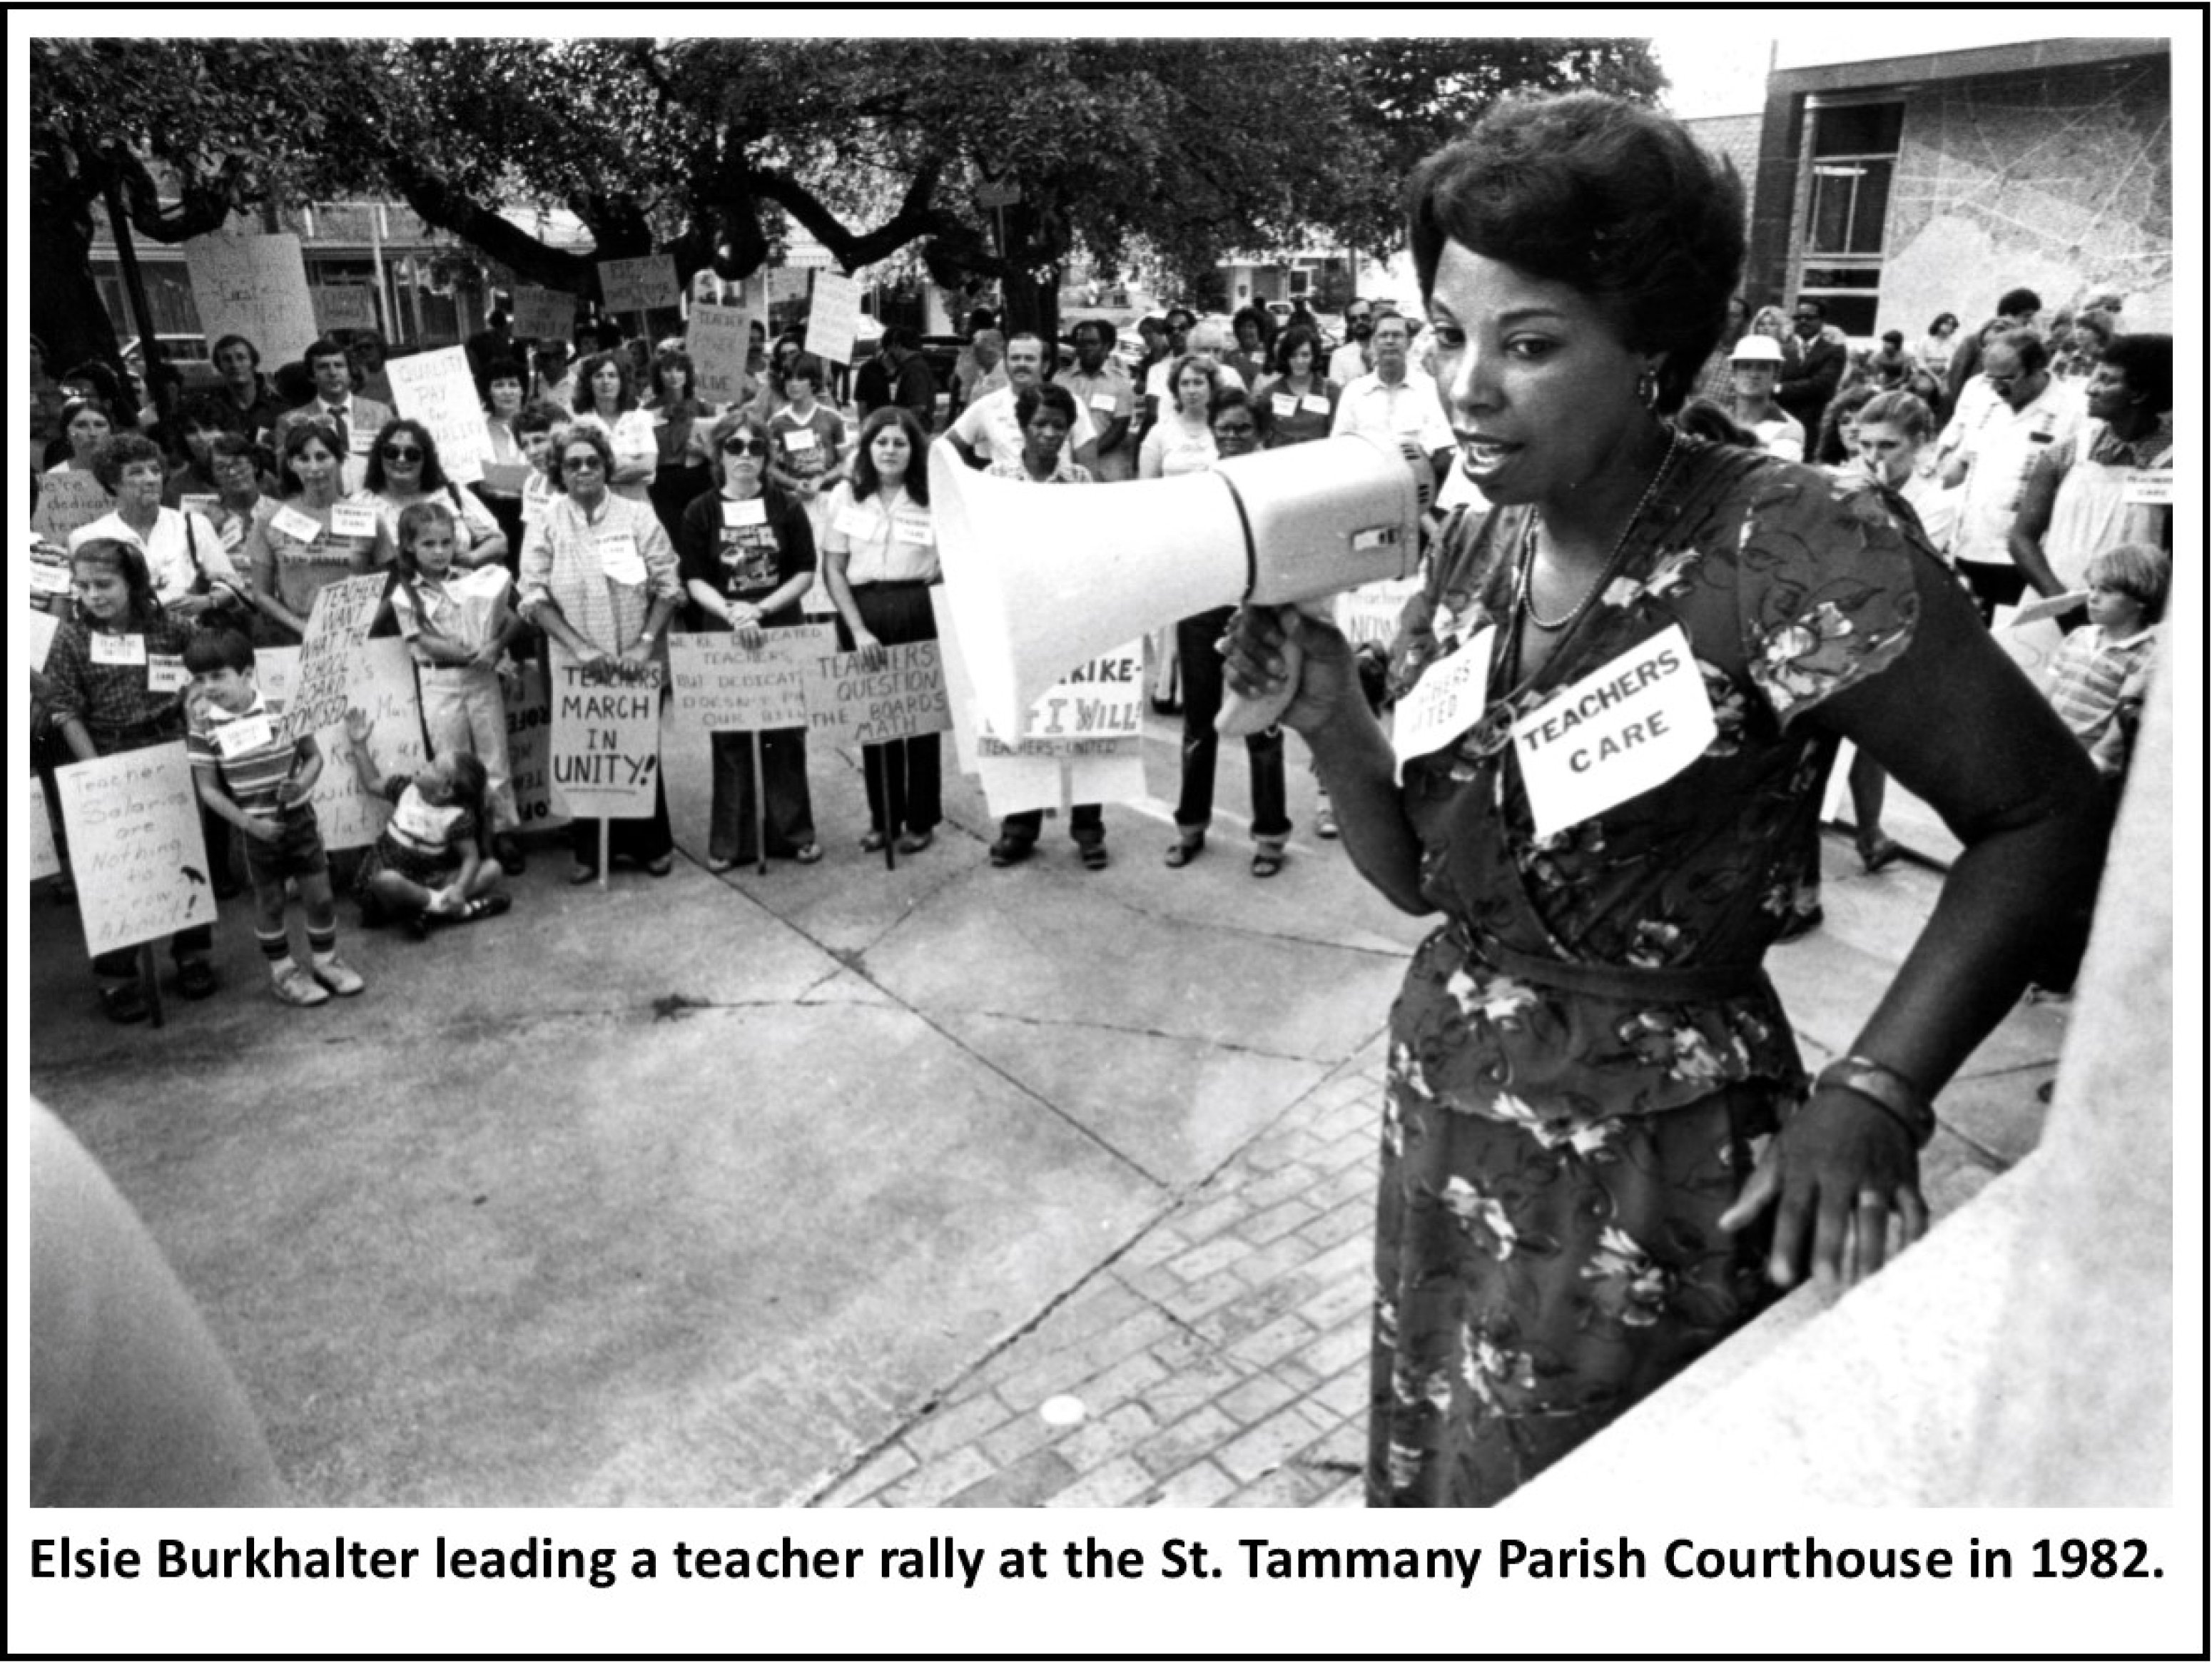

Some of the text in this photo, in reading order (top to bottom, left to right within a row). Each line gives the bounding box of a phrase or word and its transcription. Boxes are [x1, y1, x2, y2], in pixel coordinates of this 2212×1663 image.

[731, 628, 822, 647] DICATED
[718, 672, 805, 689] DEDICAT
[836, 669, 939, 702] QUESTION
[1057, 657, 1142, 685] RIKE-
[562, 695, 649, 720] MARCH
[811, 692, 947, 727] THE BOARDS
[1521, 649, 1681, 752] TEACHERS
[587, 728, 617, 750] IN
[856, 714, 917, 740] MATH
[1569, 709, 1670, 774] CARE
[69, 764, 166, 794] Teacher
[554, 753, 657, 787] UNITY!
[80, 791, 188, 824] Salaries
[115, 821, 155, 839] are
[92, 838, 182, 871] Nothing
